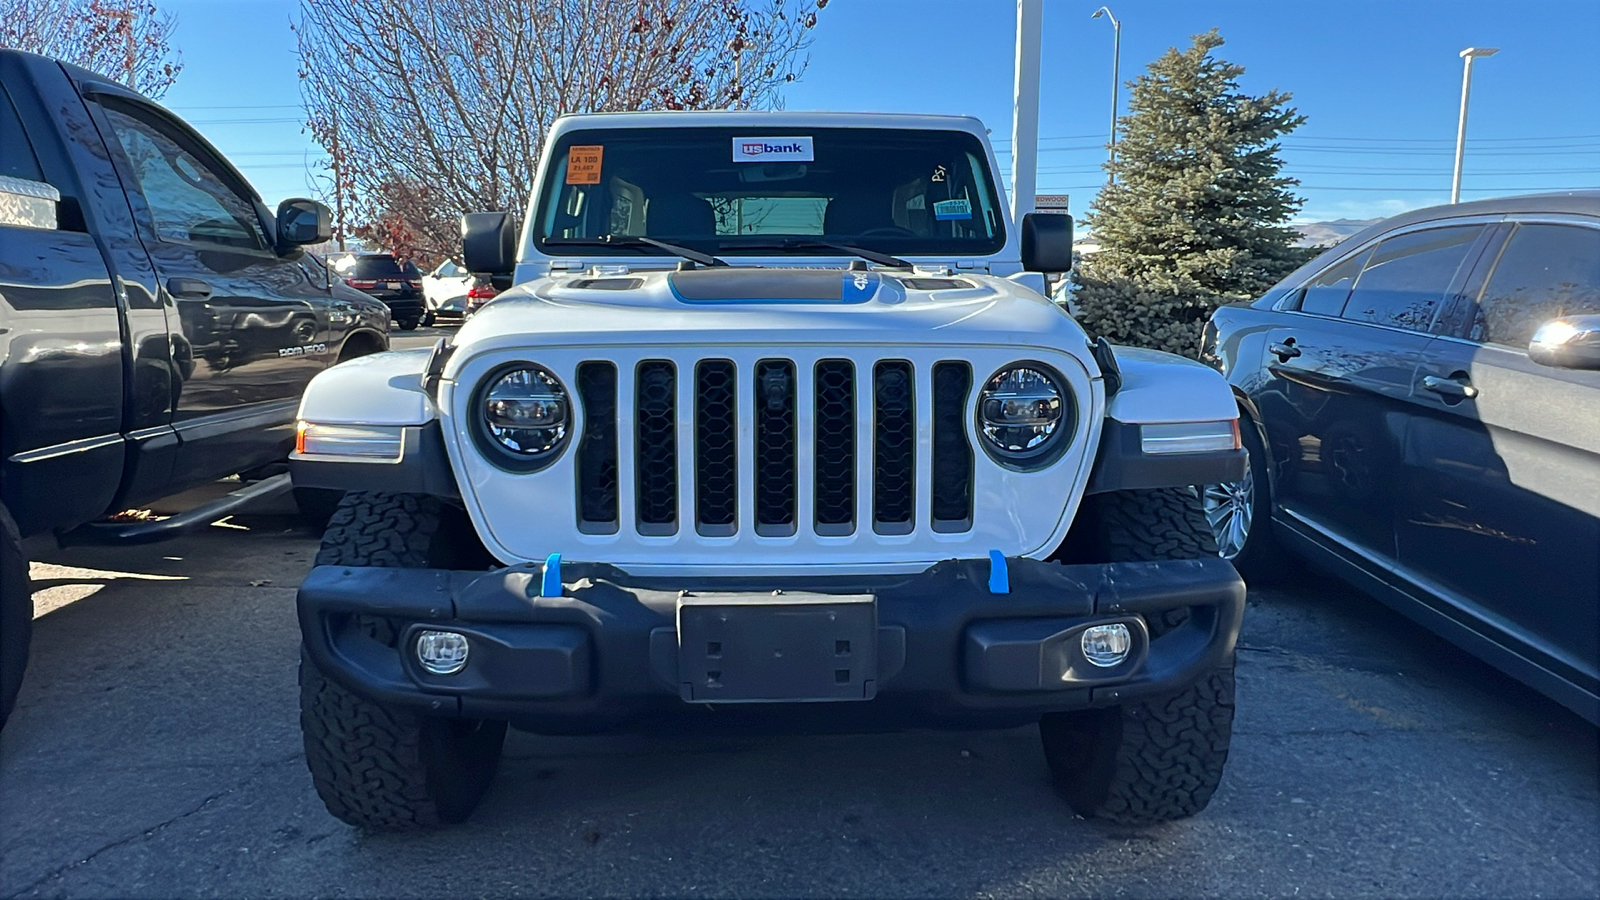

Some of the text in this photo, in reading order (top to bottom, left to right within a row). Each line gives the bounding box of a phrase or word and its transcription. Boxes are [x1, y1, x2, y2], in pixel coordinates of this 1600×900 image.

[1036, 195, 1067, 203] EDWOOD
[279, 343, 326, 357] RAM 1500
